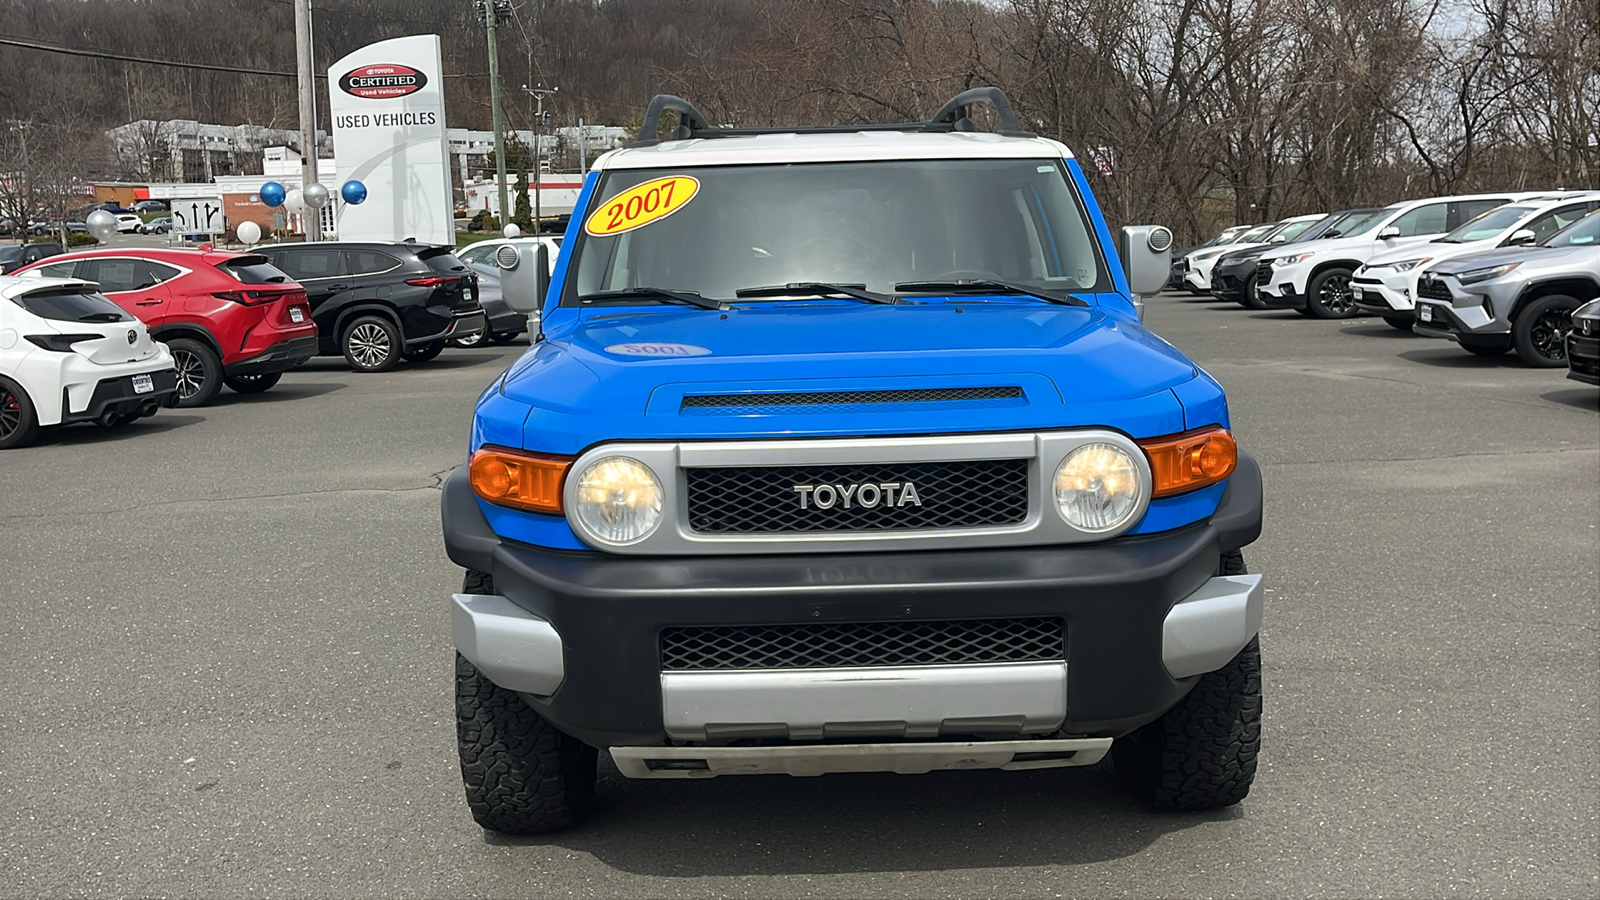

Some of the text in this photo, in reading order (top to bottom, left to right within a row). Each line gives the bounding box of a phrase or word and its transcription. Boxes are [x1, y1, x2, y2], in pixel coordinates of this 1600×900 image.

[349, 76, 416, 87] CERTIFIED
[336, 112, 436, 128] USED VEHICLES
[606, 180, 676, 231] 2007
[794, 482, 922, 510] TOYOTA
